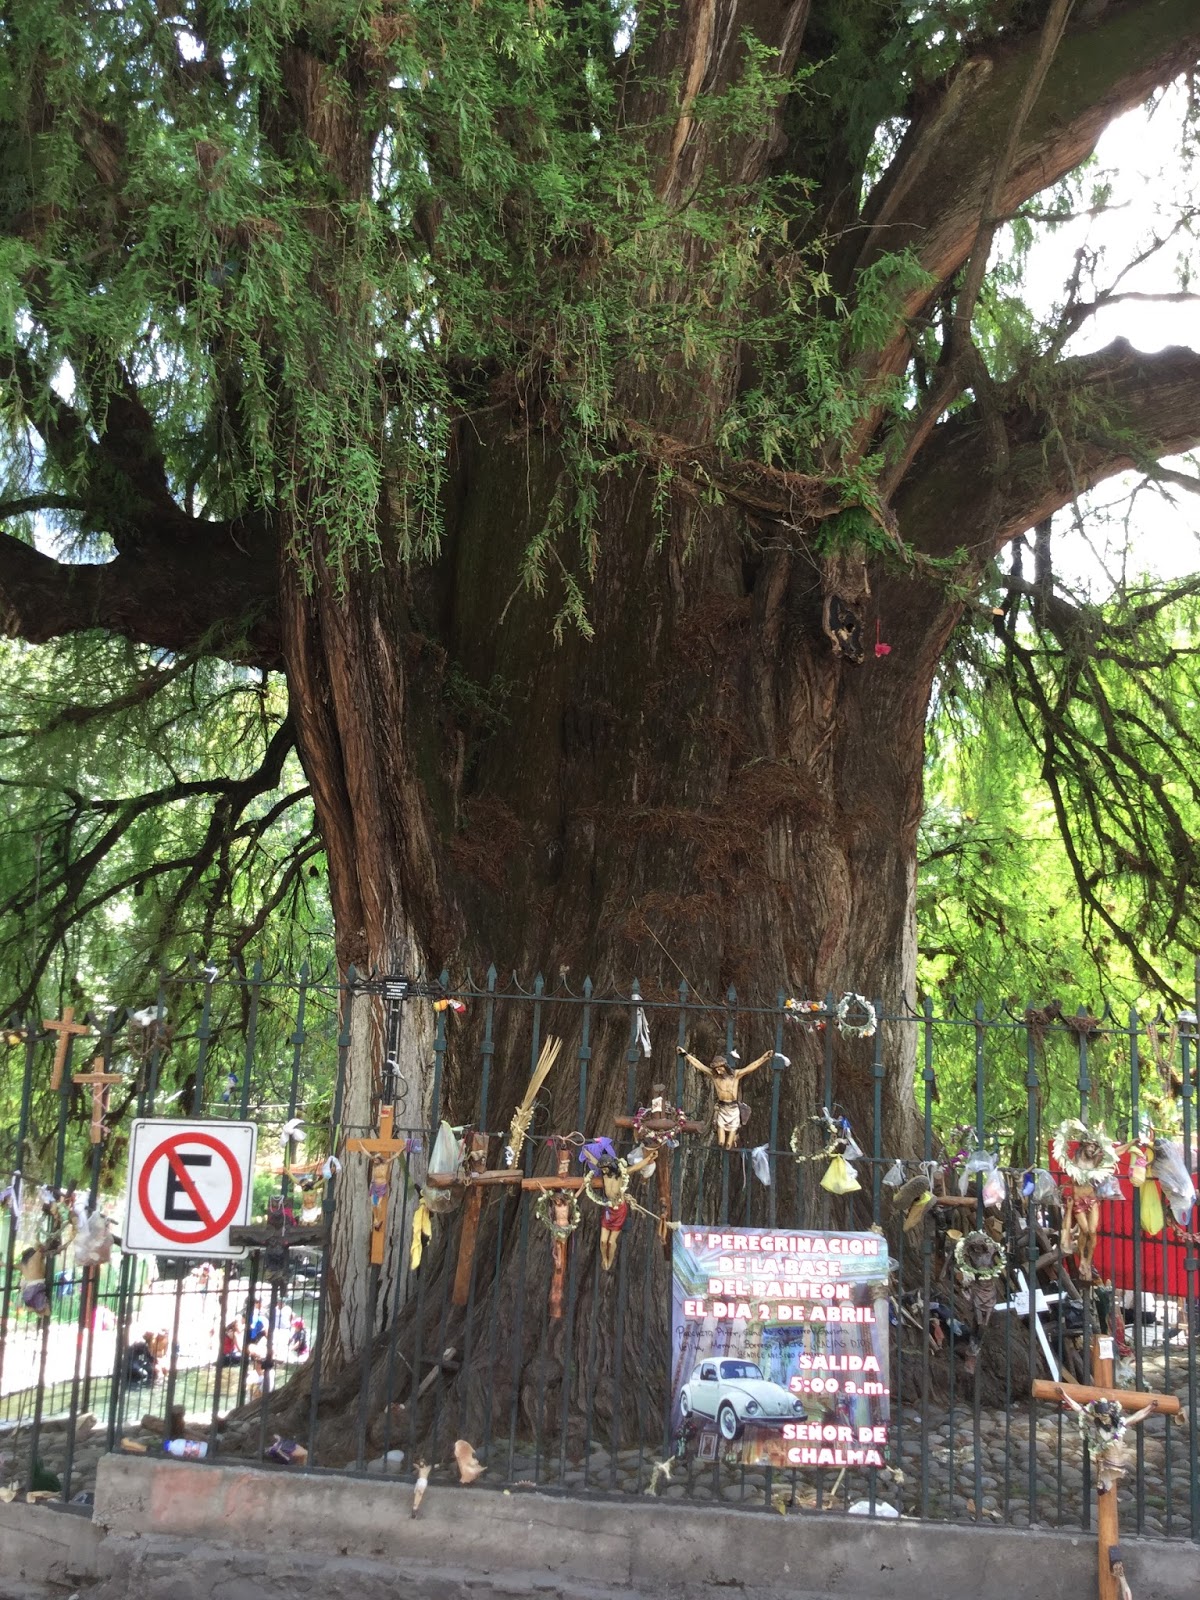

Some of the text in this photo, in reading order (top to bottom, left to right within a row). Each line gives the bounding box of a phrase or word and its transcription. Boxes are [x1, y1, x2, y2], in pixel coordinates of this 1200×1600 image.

[708, 1234, 878, 1255] PEREGRINACION
[719, 1257, 841, 1277] DE LA BASE
[709, 1279, 850, 1299] DEL PANTEON
[684, 1301, 876, 1323] EL DIA 2 DE ABRIL
[800, 1356, 880, 1372] SALIDA
[790, 1377, 889, 1394] 5:00 a.m.
[783, 1421, 886, 1443] SEÑOR DE
[788, 1448, 882, 1466] CHALMA
